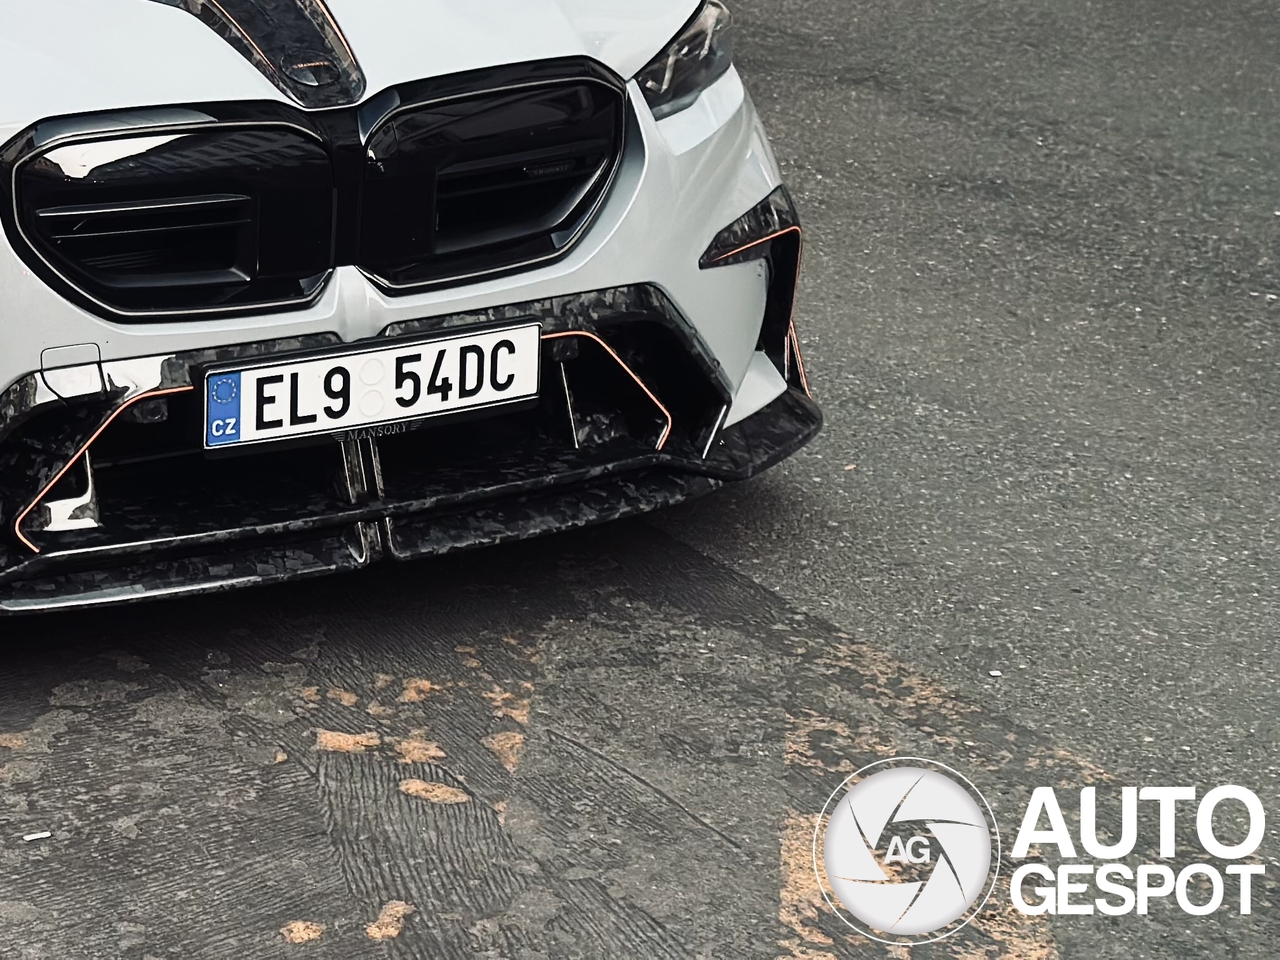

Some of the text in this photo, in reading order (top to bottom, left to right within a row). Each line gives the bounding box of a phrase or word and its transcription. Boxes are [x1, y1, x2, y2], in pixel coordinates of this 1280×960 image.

[255, 339, 517, 431] EL9 54DC
[212, 417, 237, 438] CZ
[347, 421, 409, 442] MANSORY
